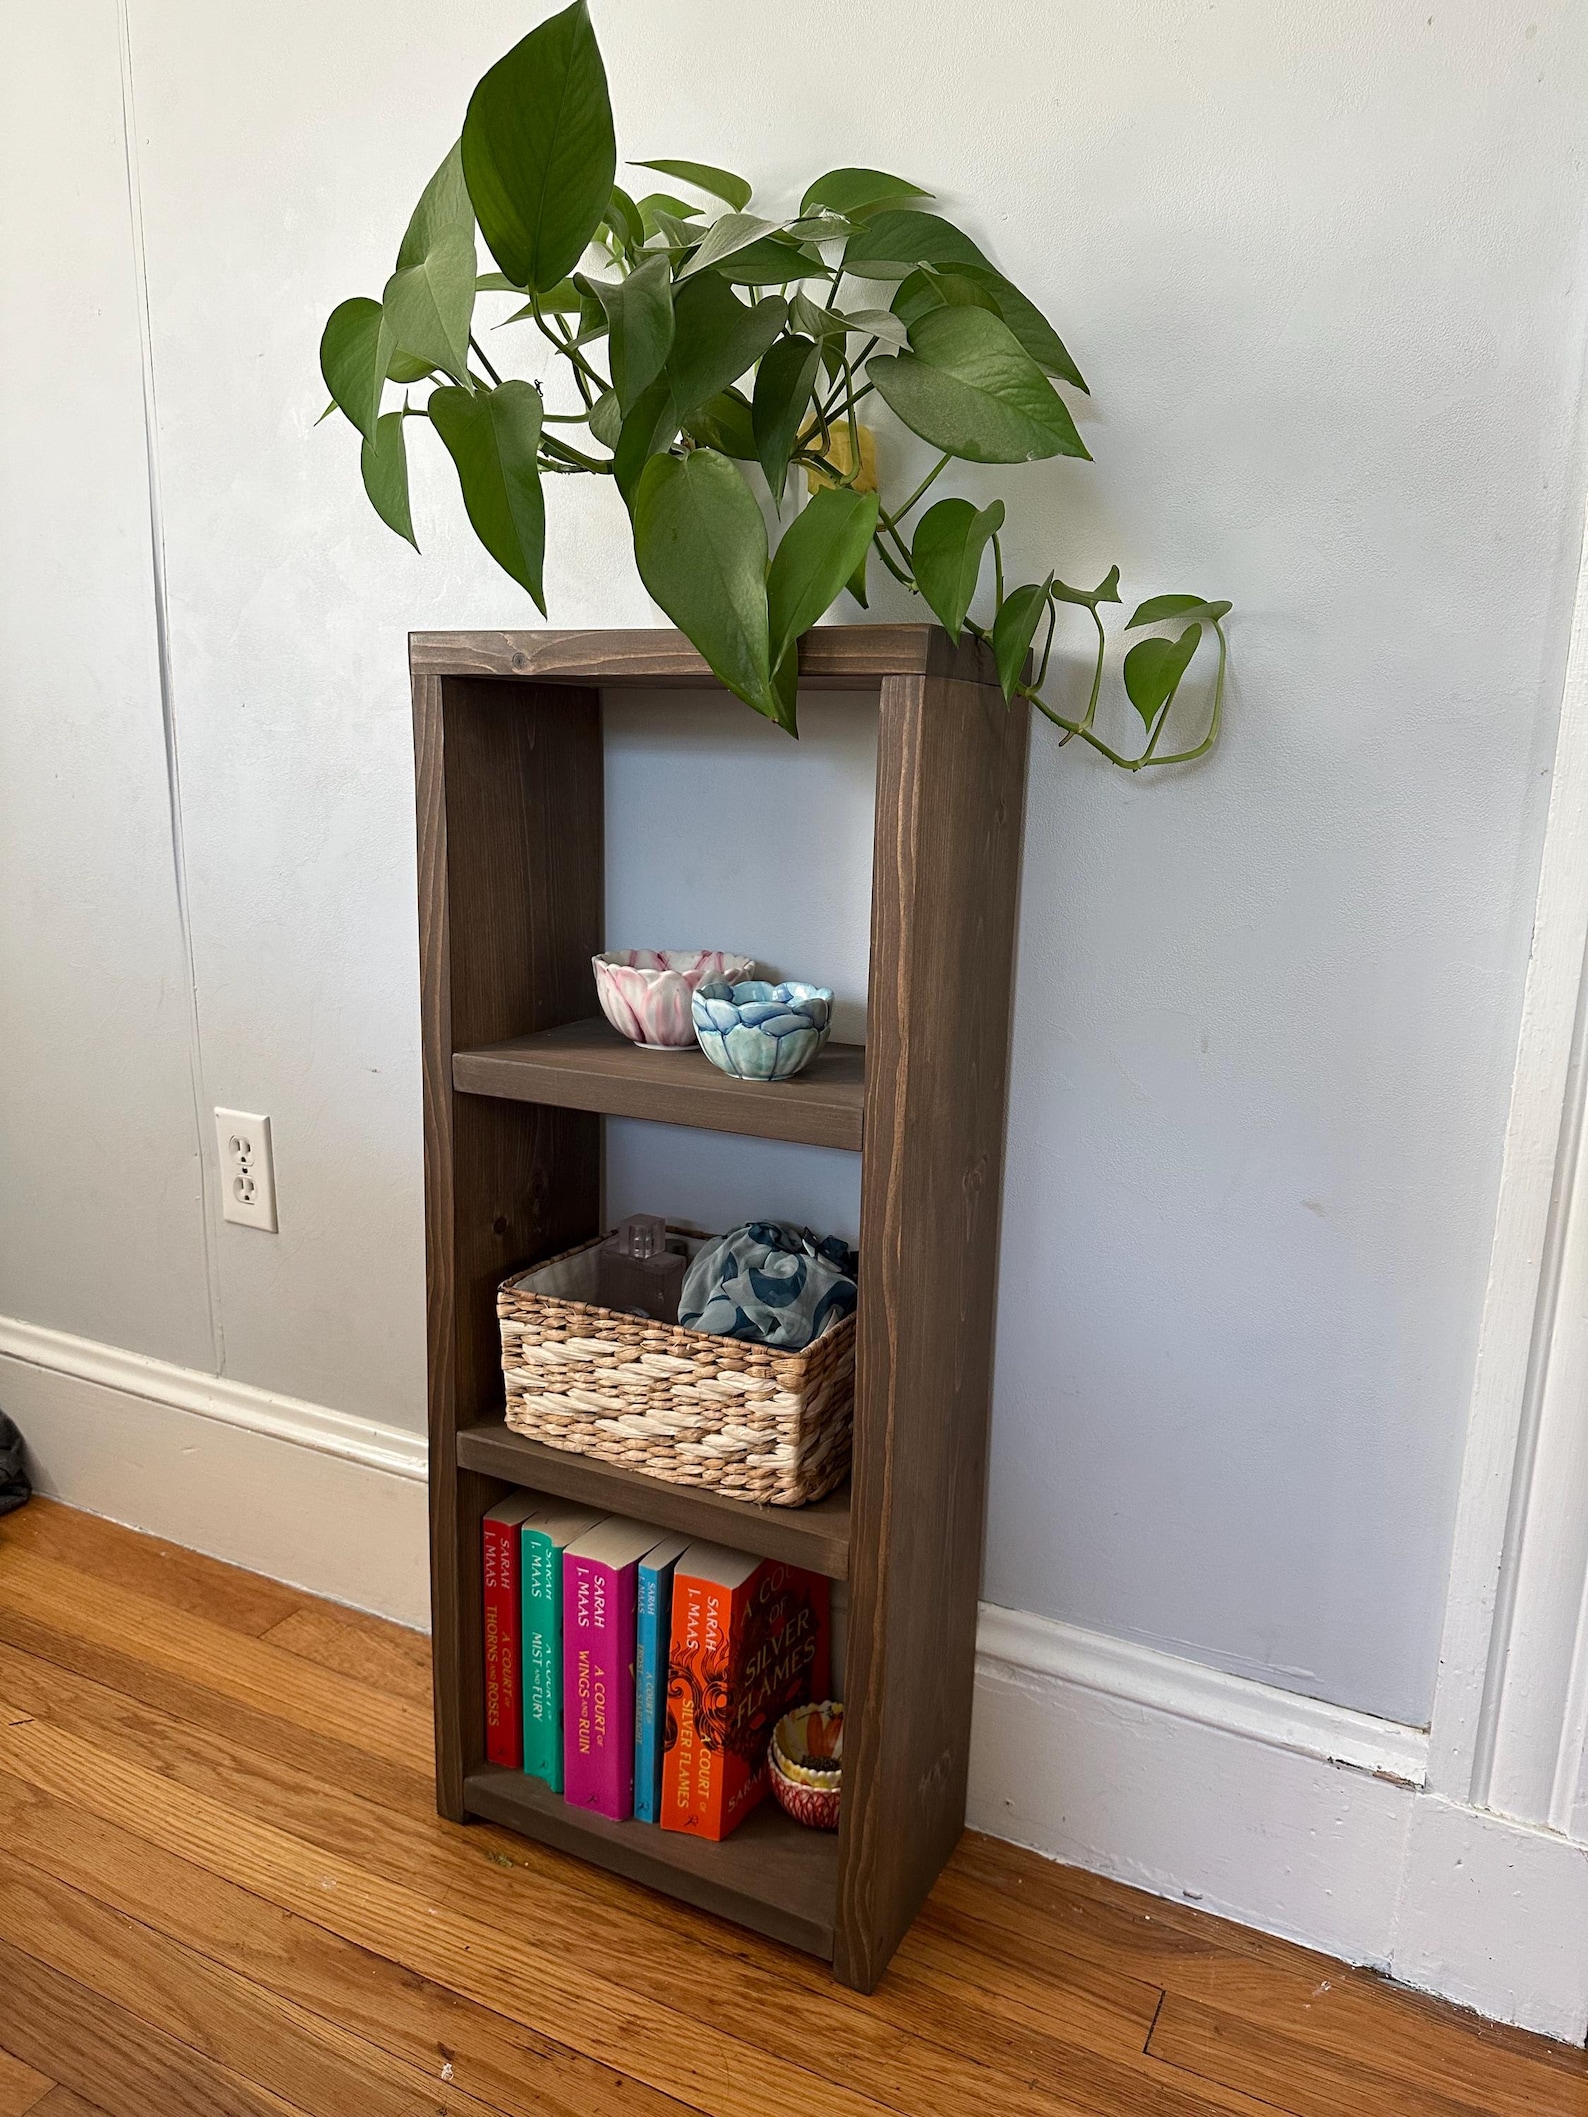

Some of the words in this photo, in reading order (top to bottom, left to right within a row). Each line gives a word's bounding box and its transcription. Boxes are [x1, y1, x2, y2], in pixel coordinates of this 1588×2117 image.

[484, 1531, 496, 1540] J.
[530, 1541, 542, 1549] J.
[485, 1544, 497, 1588] MAAS
[500, 1538, 510, 1589] SARAH
[531, 1554, 542, 1598] MAAS
[576, 1566, 590, 1576] J.
[578, 1581, 590, 1627] MAAS
[594, 1575, 606, 1628] SARAH
[648, 1582, 656, 1615] SARAH
[688, 1587, 701, 1597] J.
[741, 1600, 752, 1627] A
[769, 1596, 788, 1623] OF
[487, 1605, 498, 1662] THORNS
[502, 1632, 511, 1642] A
[687, 1602, 701, 1650] MAAS
[705, 1596, 719, 1651] SARAH
[532, 1631, 543, 1667] MIST
[744, 1608, 810, 1688] SILVER
[502, 1647, 513, 1696] COURT
[579, 1650, 590, 1698] WINGS
[594, 1665, 605, 1677] A
[736, 1636, 817, 1730] FLAMES
[488, 1681, 499, 1727] ROSES
[532, 1685, 543, 1722] FURY
[581, 1699, 589, 1717] AND
[594, 1683, 606, 1735] COURT
[680, 1699, 694, 1747] SILVER
[579, 1718, 590, 1754] RUIN
[700, 1732, 711, 1743] A
[677, 1747, 692, 1809] FLAMES
[698, 1748, 712, 1799] COURT
